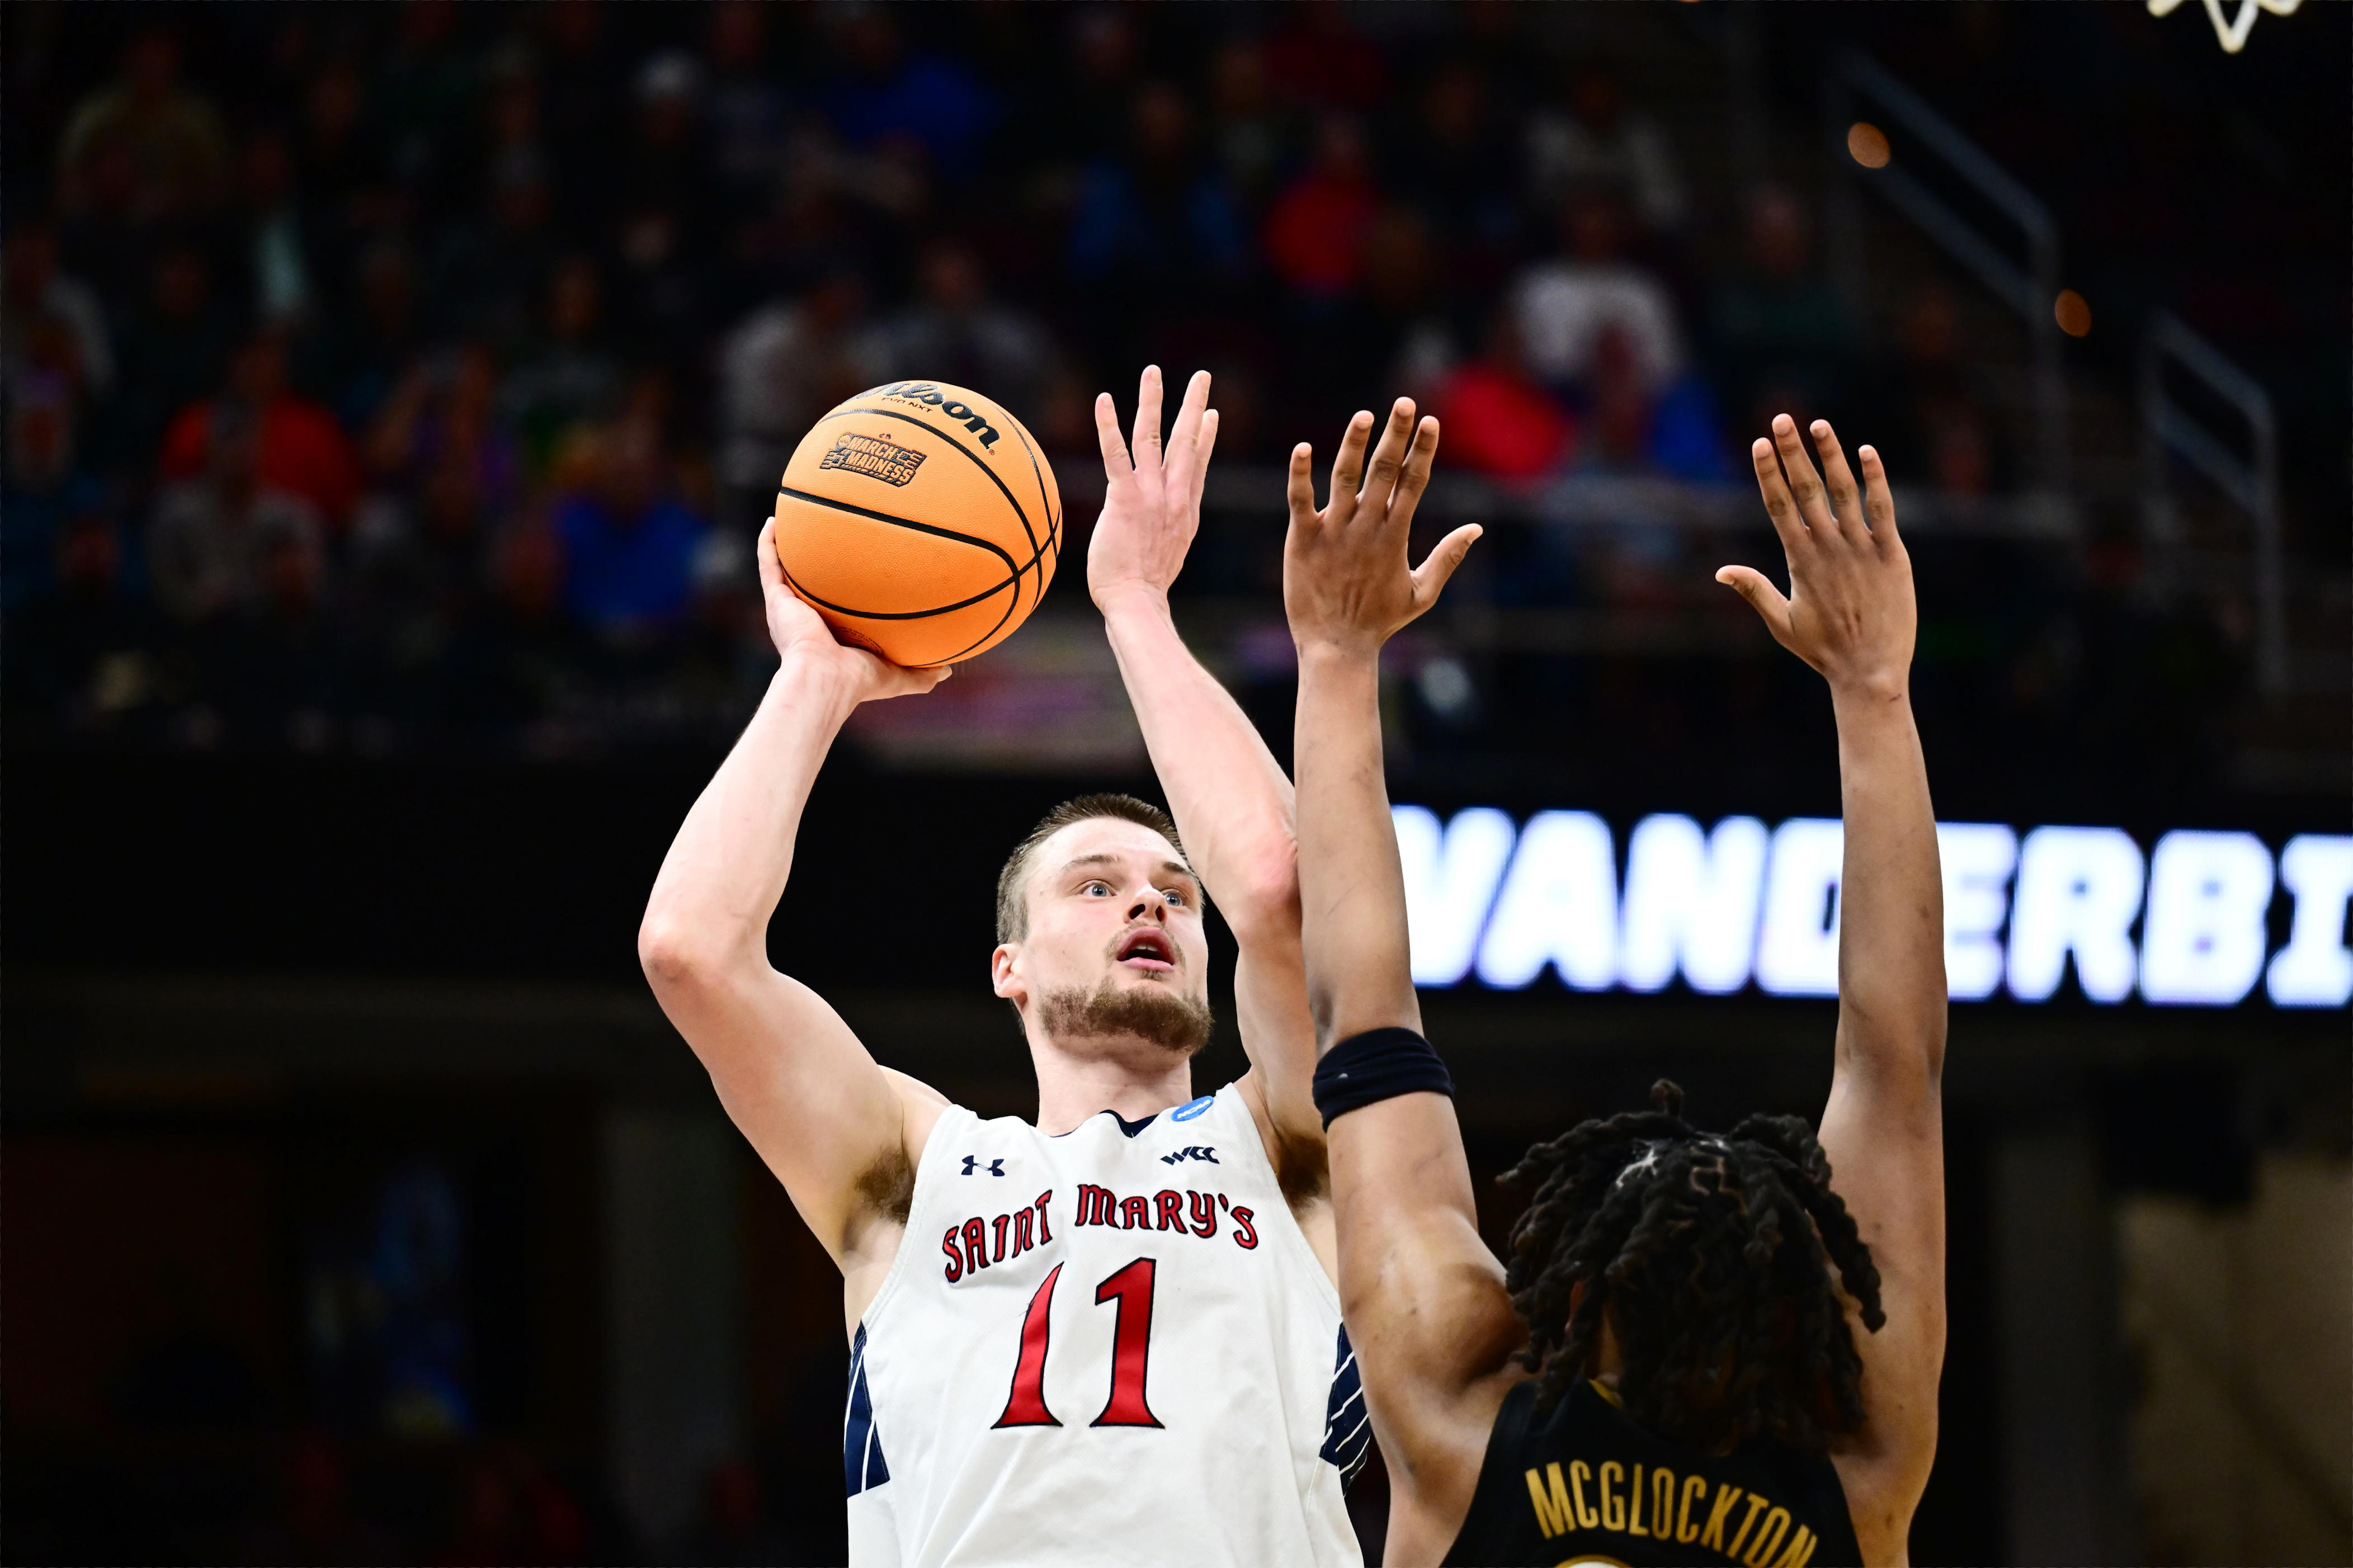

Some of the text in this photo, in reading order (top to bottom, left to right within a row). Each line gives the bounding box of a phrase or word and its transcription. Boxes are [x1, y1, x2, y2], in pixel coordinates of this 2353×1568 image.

[908, 402, 933, 413] NXT
[847, 436, 899, 460] MARCH
[845, 451, 914, 483] MADNESS
[1160, 1146, 1220, 1166] WCC
[942, 1184, 1258, 1283] SAINT MARY'S
[991, 1257, 1165, 1429] 11
[1525, 1460, 1818, 1568] MCGLOCKTON
